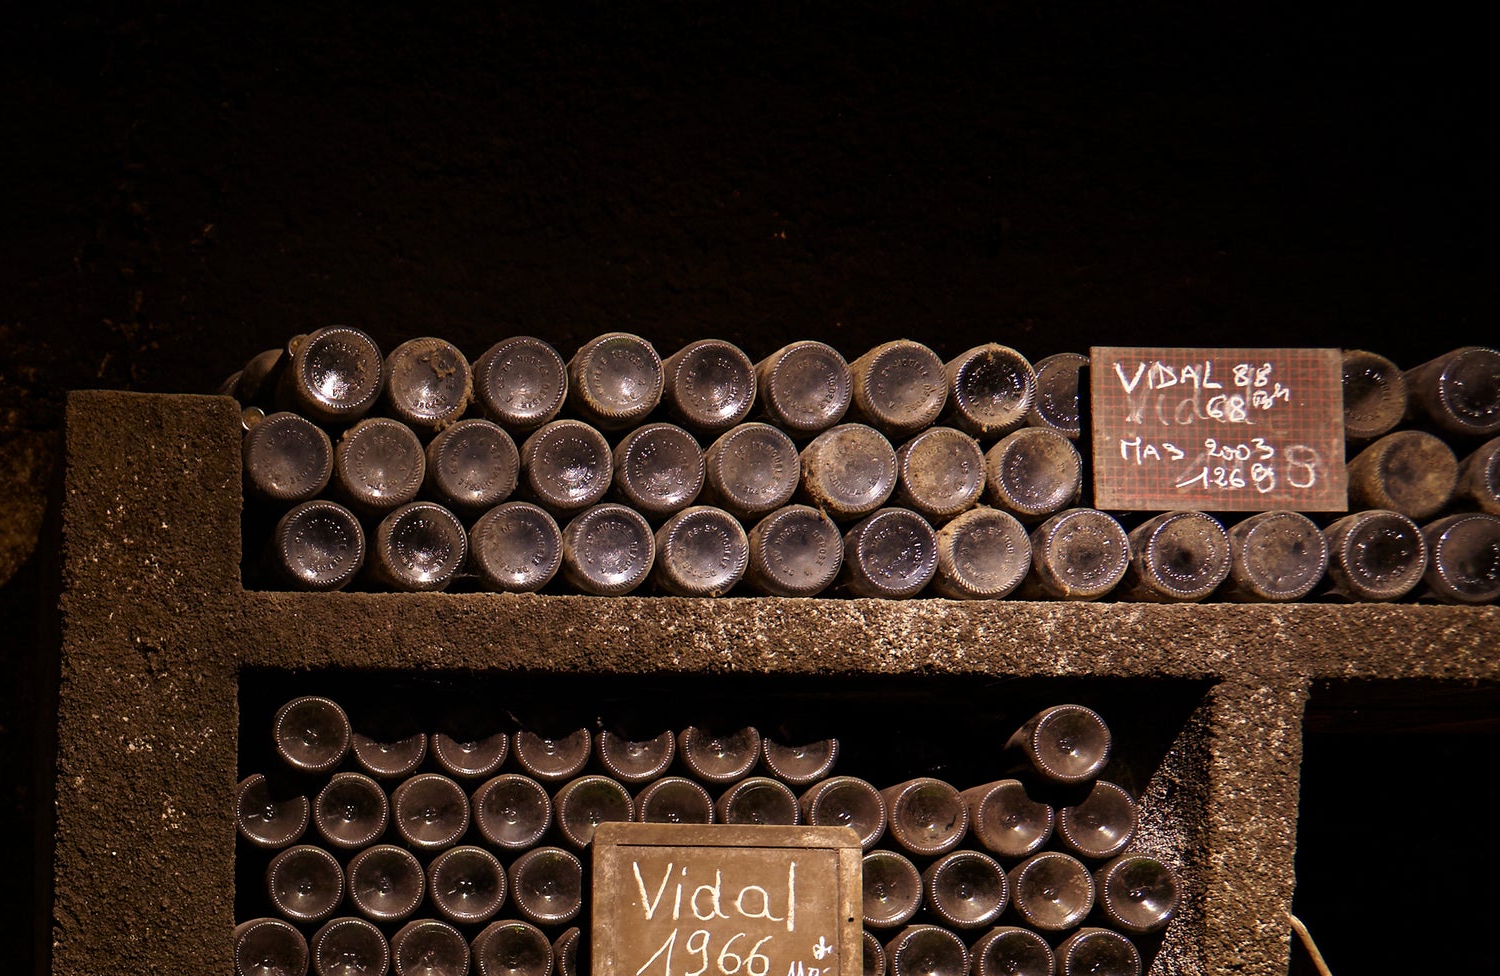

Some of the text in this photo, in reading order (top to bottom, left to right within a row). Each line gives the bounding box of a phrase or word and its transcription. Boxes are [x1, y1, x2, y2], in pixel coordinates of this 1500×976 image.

[1113, 360, 1223, 394] VIDAL
[1203, 437, 1276, 462] 2003
[632, 861, 797, 932] Vidal
